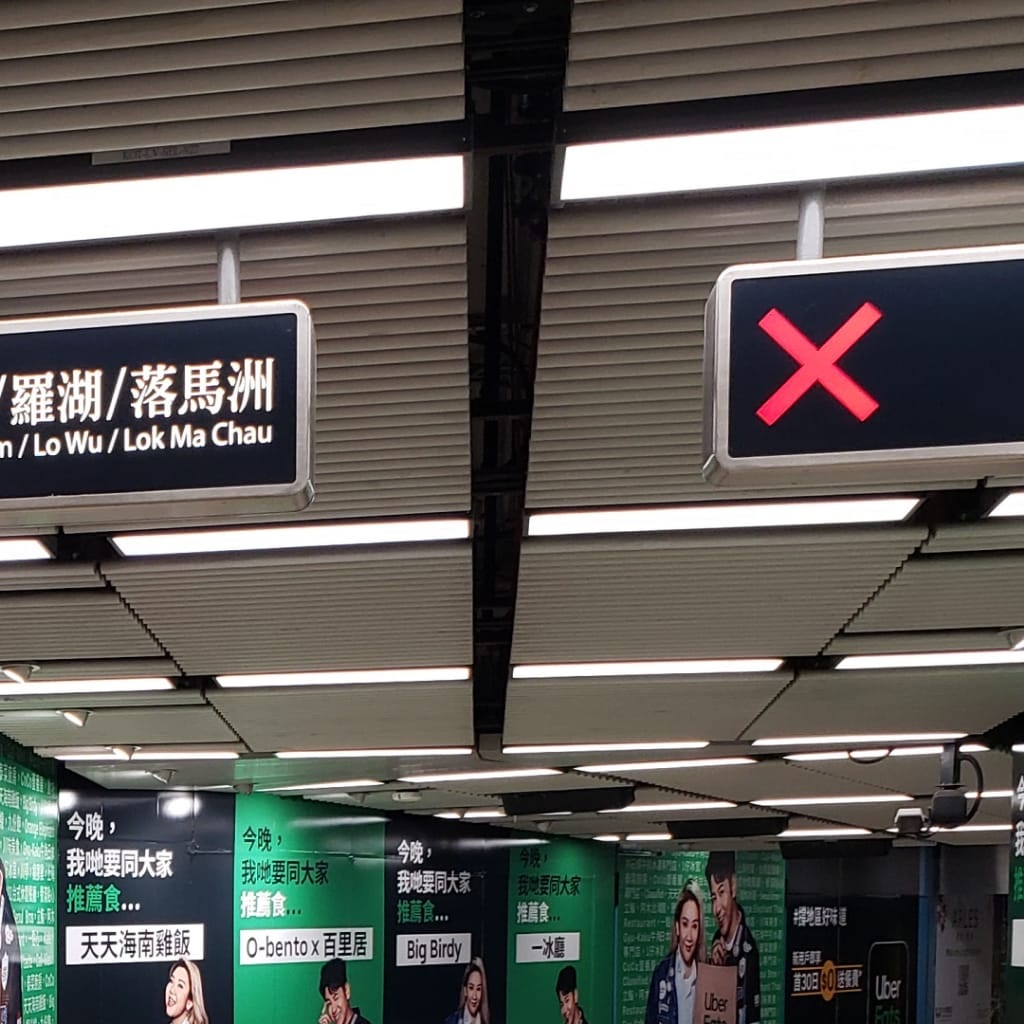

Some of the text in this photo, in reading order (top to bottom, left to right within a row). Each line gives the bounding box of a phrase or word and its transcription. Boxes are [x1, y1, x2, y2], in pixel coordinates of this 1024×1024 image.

[33, 432, 61, 457] Lo
[64, 430, 103, 455] Wu
[123, 424, 166, 451] Lok
[170, 424, 206, 449] Ma
[211, 420, 273, 446] Chau
[246, 936, 308, 957] O-bento
[407, 937, 462, 961] Big Birdy
[875, 975, 901, 1000] Uber
[704, 992, 728, 1012] Uber
